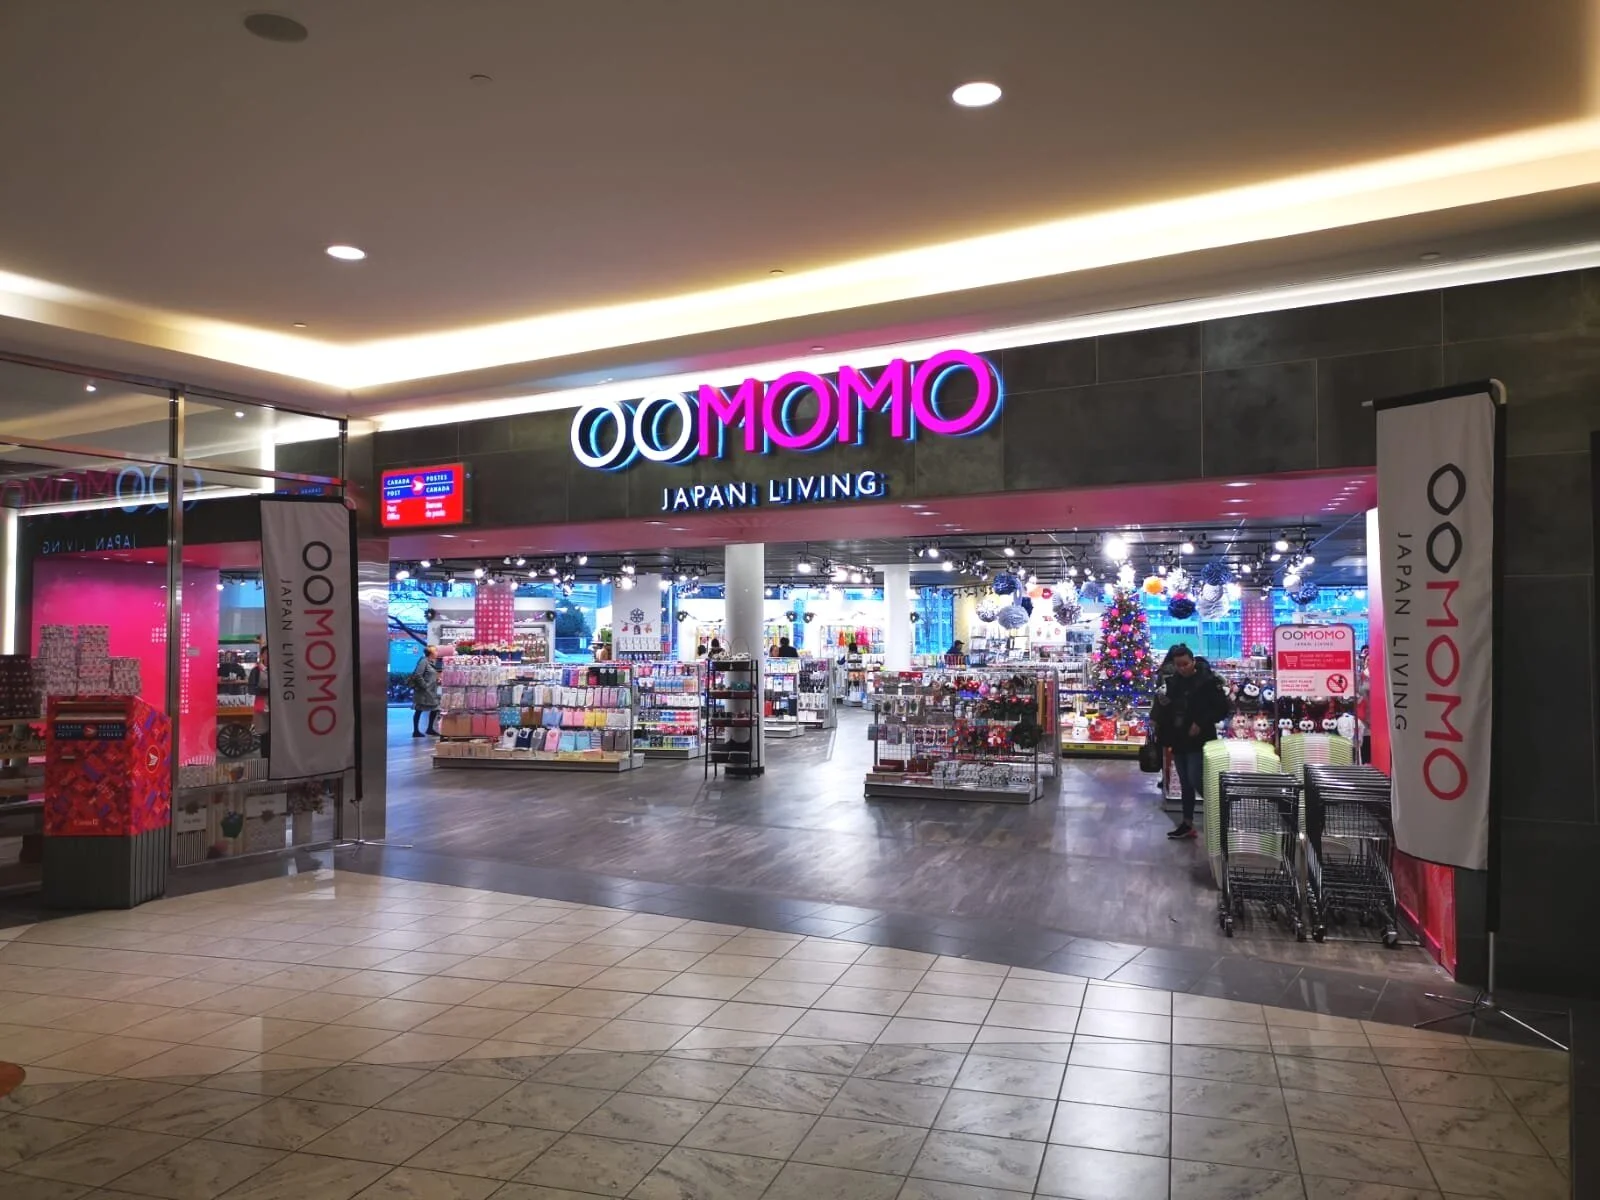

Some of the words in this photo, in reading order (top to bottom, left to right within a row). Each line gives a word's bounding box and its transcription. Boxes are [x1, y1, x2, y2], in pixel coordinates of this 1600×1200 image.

[570, 349, 1000, 470] OOMOMO
[387, 478, 410, 486] CANADA
[426, 474, 448, 482] POSTES
[426, 485, 450, 493] CANADA
[662, 482, 748, 511] JAPAN
[768, 470, 878, 502] LIVING
[1395, 533, 1413, 616] JAPAN
[281, 579, 293, 631] JAPAN
[1423, 462, 1468, 801] OOMOMO
[302, 541, 337, 736] OOMOMO
[1282, 630, 1346, 640] OOMOMO
[282, 643, 295, 701] LIVING
[1392, 636, 1410, 731] LIVING
